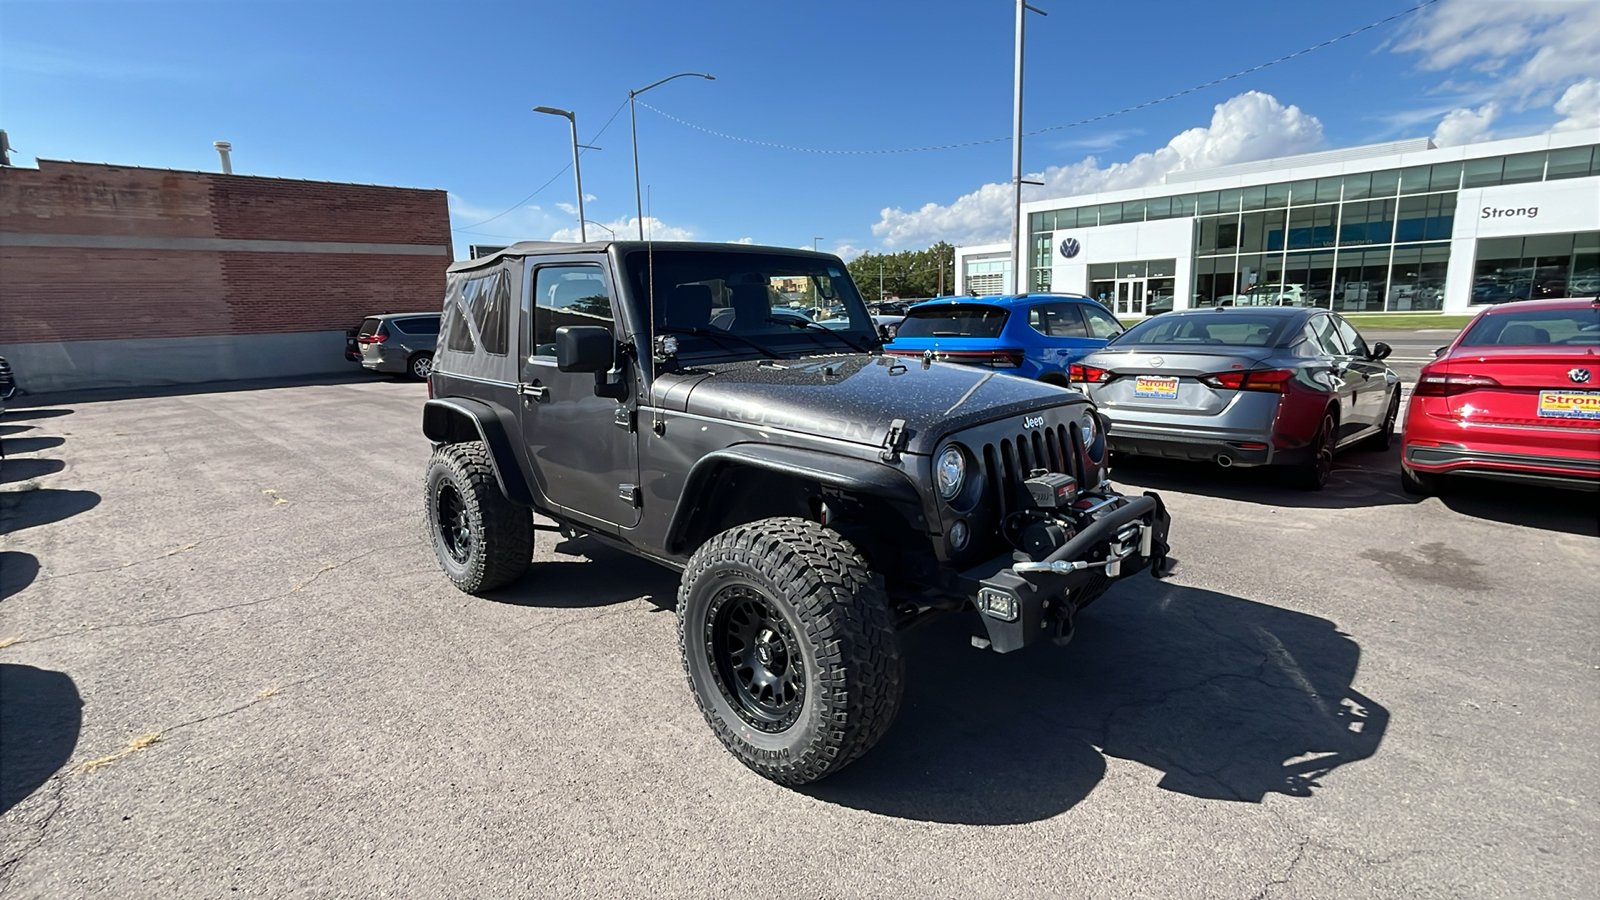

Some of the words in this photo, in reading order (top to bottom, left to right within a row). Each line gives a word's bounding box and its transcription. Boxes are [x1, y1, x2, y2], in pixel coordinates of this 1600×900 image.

[1481, 206, 1539, 219] Strong
[1322, 239, 1373, 247] Volswagn
[1138, 379, 1176, 389] Strong
[1023, 416, 1044, 429] Jeep
